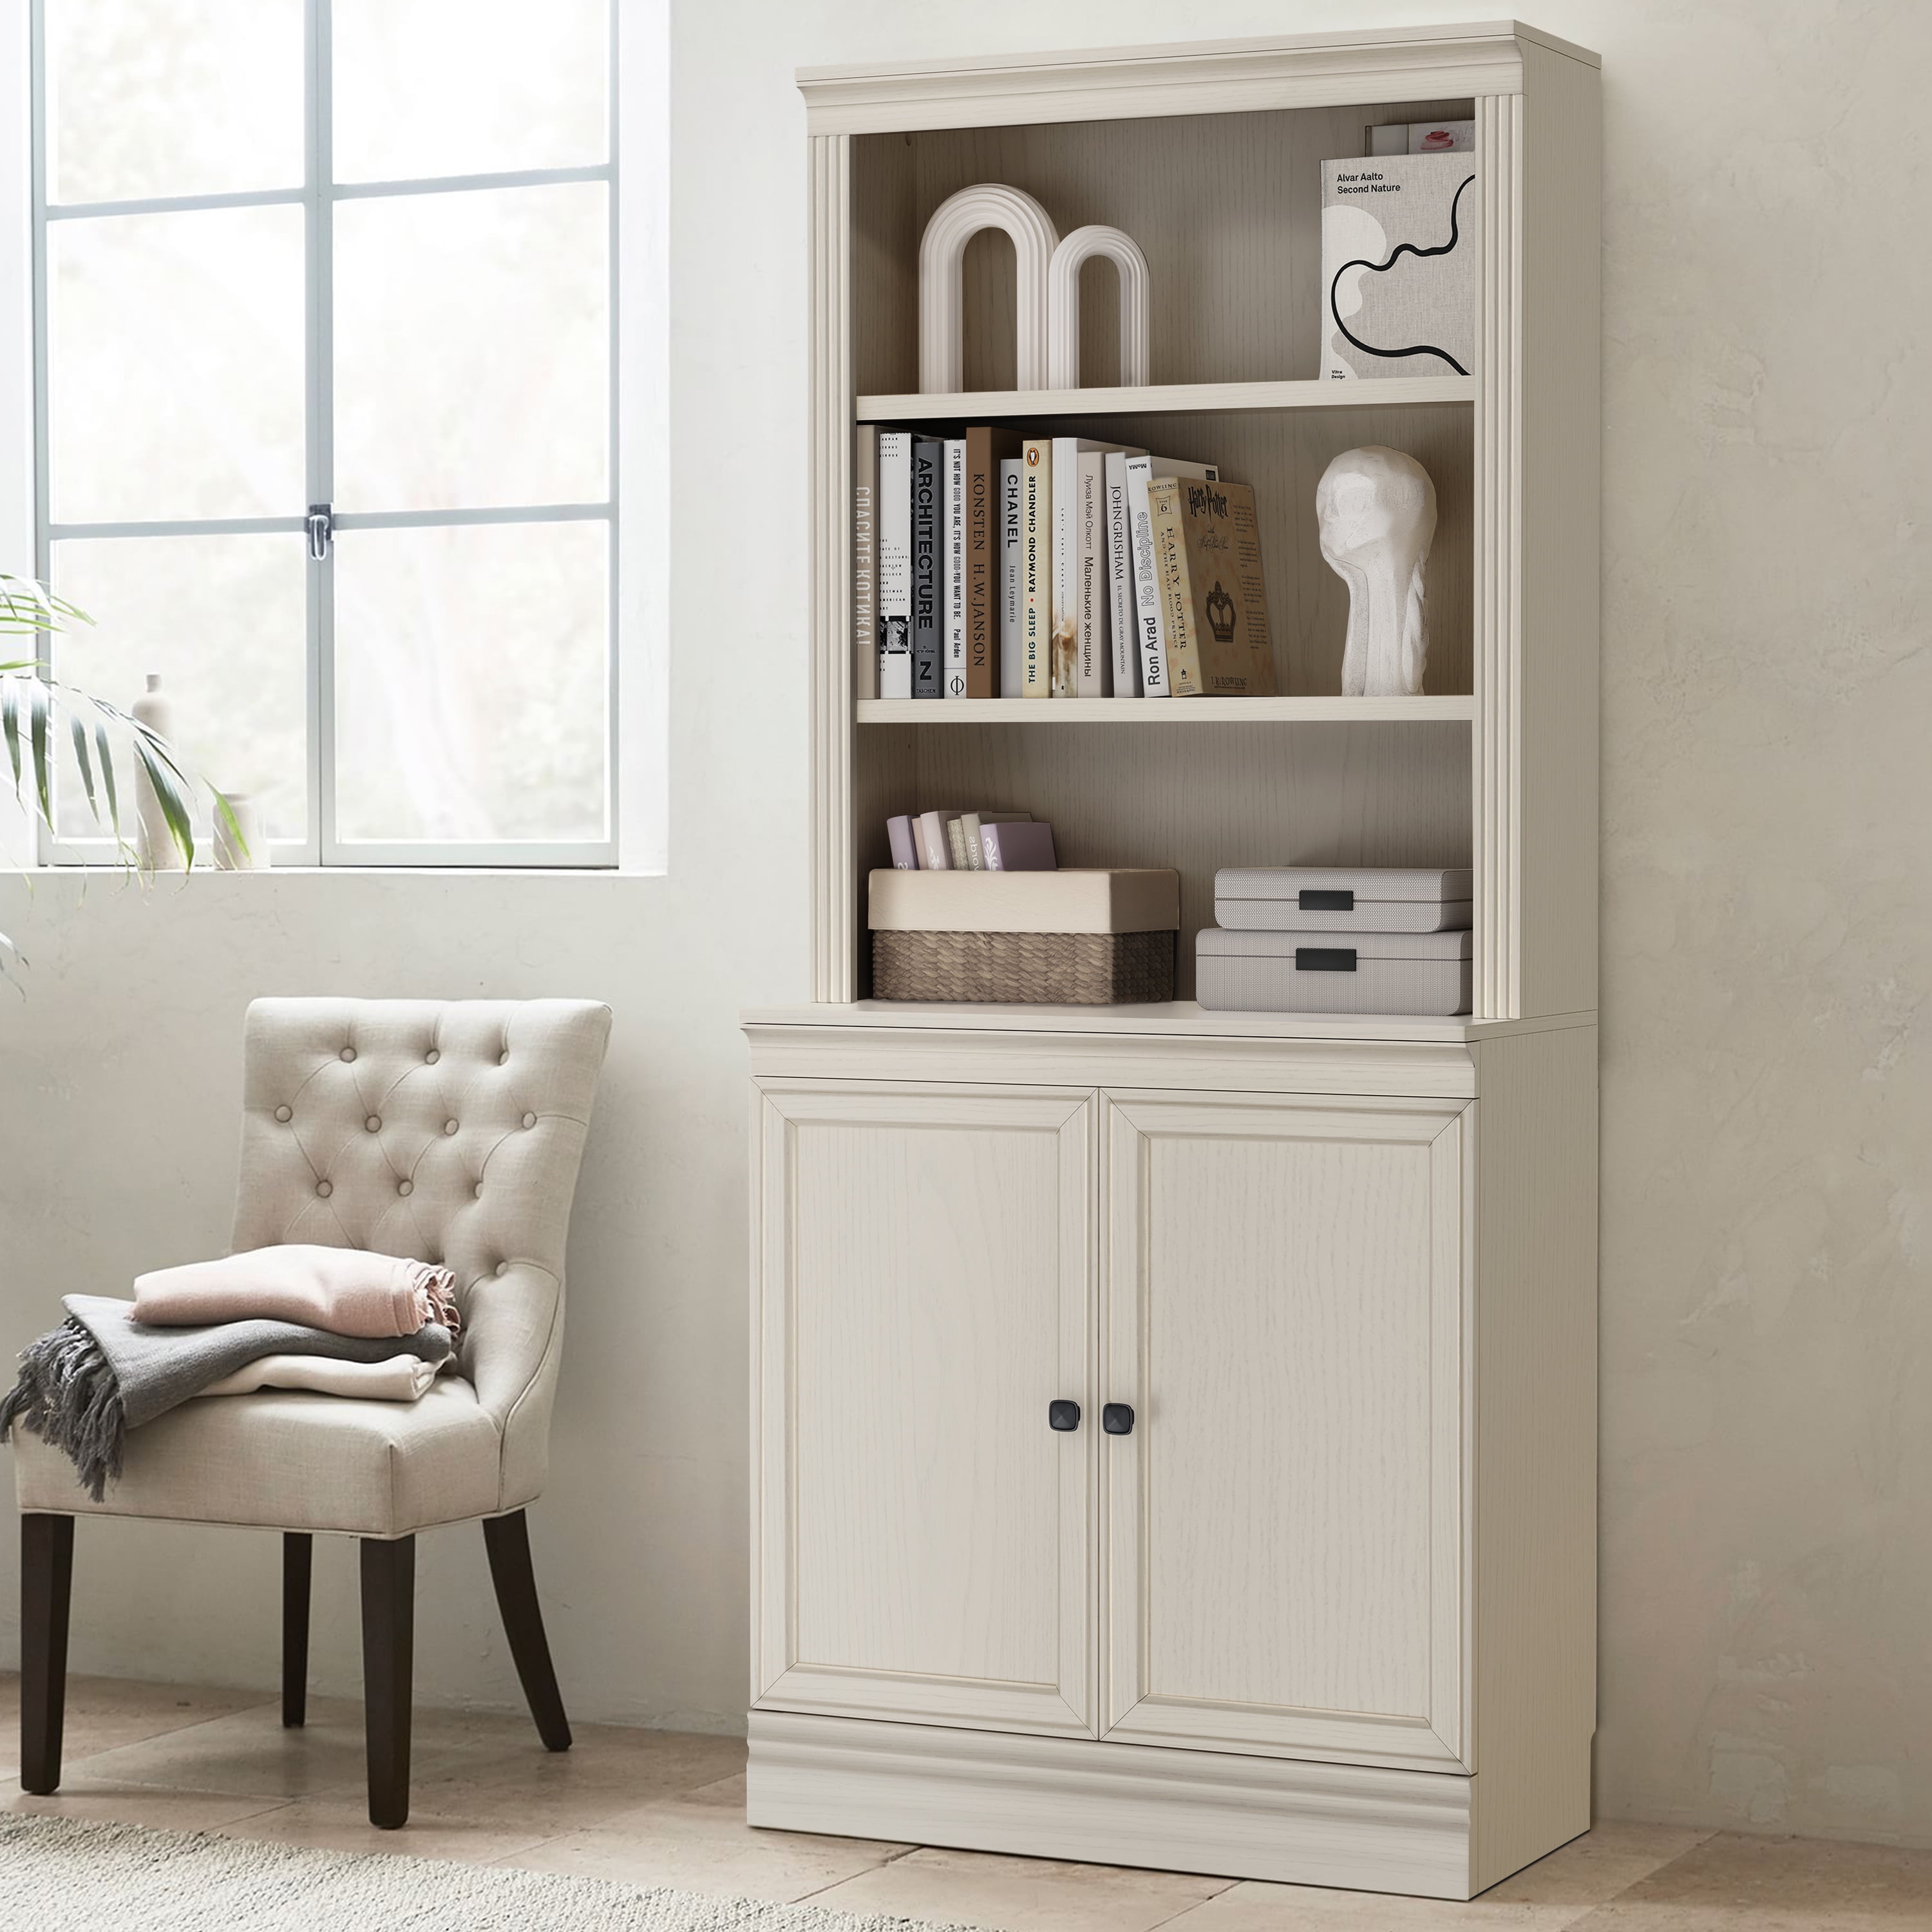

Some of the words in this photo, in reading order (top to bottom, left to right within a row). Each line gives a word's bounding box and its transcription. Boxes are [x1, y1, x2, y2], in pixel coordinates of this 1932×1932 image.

[1338, 184, 1368, 194] Second
[1371, 184, 1401, 193] Nature
[1360, 173, 1383, 181] Aalto
[1084, 475, 1093, 499] Луиза
[1188, 486, 1207, 517] Harry
[1206, 484, 1229, 524] Potter
[952, 516, 961, 528] ARE,
[973, 473, 985, 551] KONSTEN
[1007, 475, 1018, 548] CHANEL
[1160, 504, 1168, 512] 6
[918, 457, 933, 629] ARCHITECTURE
[1085, 521, 1094, 550] Олкотт
[1136, 511, 1153, 581] Discipline
[1008, 586, 1016, 623] Leymarie
[1084, 557, 1094, 620] Маленькие
[1141, 586, 1155, 607] No
[1167, 527, 1180, 586] HARRY
[1174, 592, 1186, 649] POTTER
[1083, 623, 1092, 677] женщины
[1143, 617, 1158, 651] Arad
[1148, 656, 1160, 685] Ron
[1221, 677, 1247, 686] ROWLING
